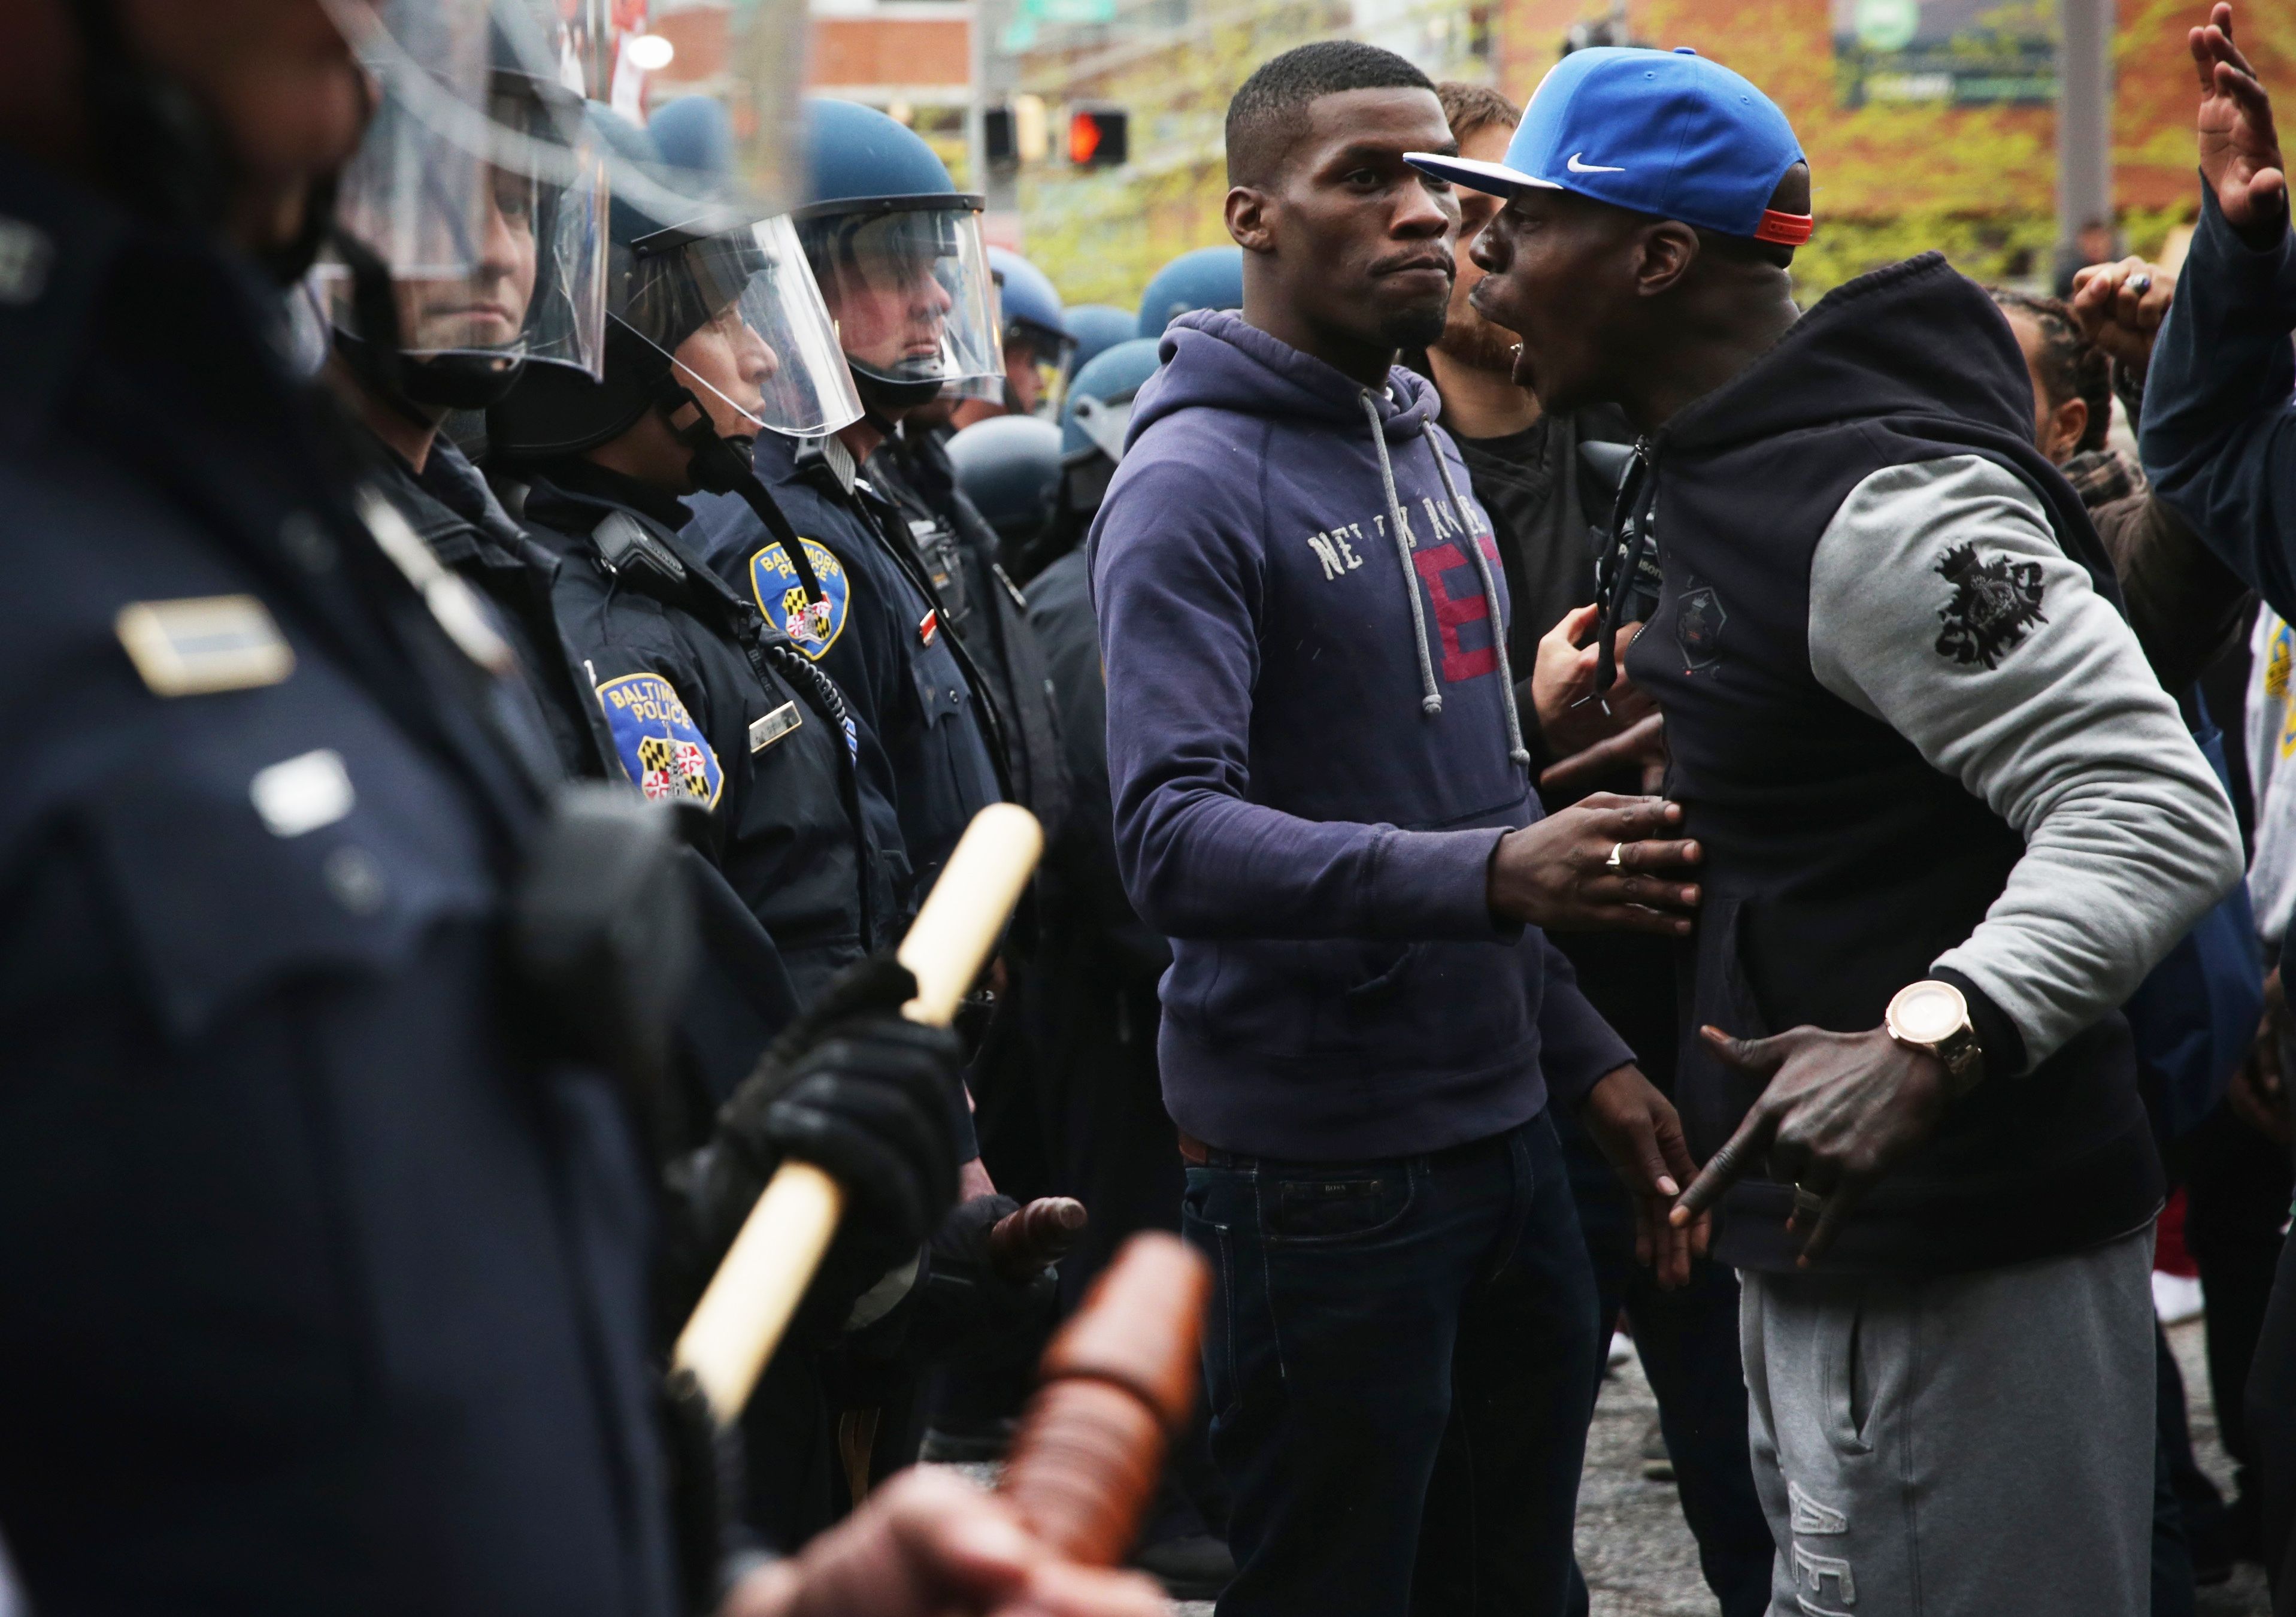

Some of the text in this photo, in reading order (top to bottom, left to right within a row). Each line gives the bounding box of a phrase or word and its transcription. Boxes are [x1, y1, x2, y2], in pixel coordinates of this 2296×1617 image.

[760, 546, 839, 577] BALMORE
[1307, 516, 1385, 580] NE
[778, 560, 827, 582] POCE
[608, 682, 683, 709] BALTIM
[631, 700, 690, 730] POLICE
[1788, 1480, 1856, 1617] AE
